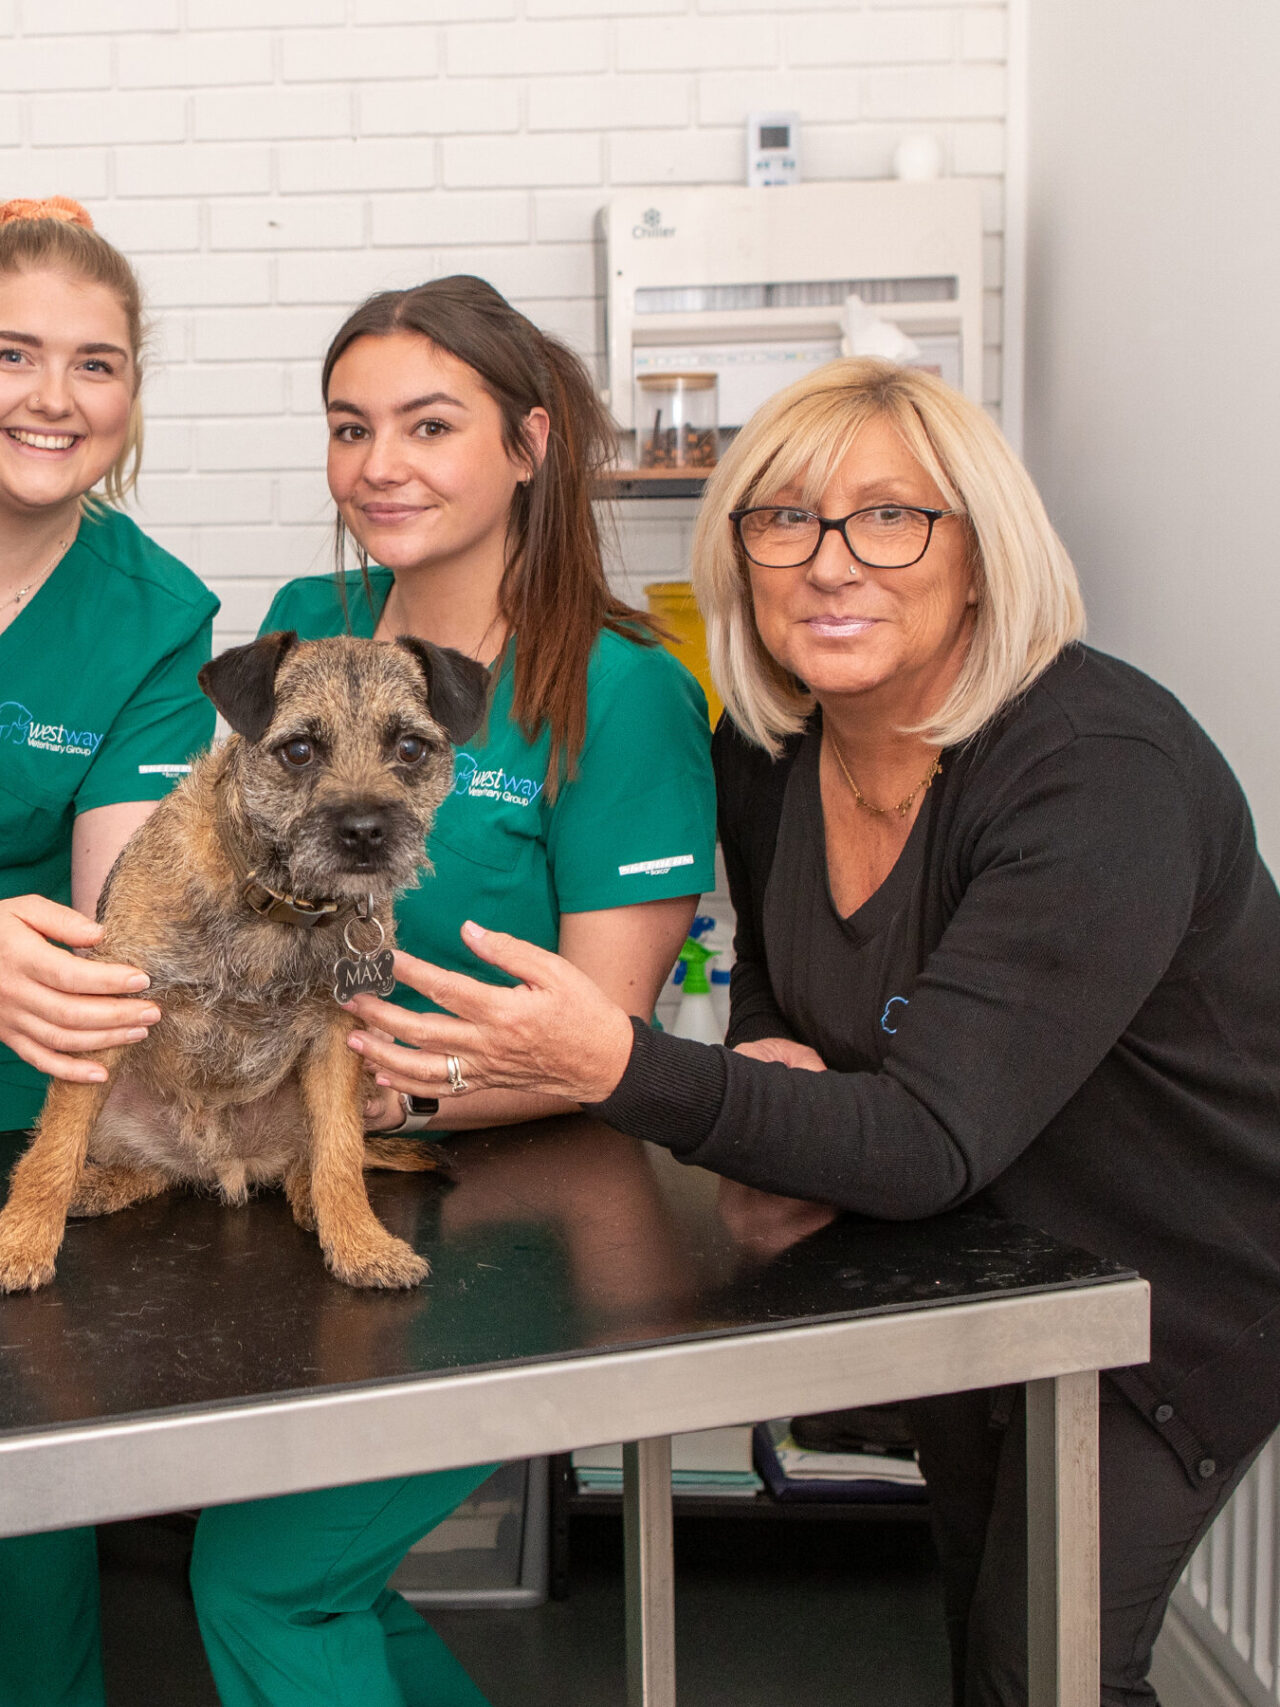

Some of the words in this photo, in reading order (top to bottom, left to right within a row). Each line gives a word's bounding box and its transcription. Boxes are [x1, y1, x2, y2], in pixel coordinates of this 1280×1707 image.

[632, 224, 676, 239] Chiller
[27, 737, 65, 754] Veterinary
[65, 744, 91, 757] Group
[29, 721, 104, 753] westway
[471, 767, 544, 804] westway
[502, 791, 529, 807] Group
[345, 962, 383, 987] MAX
